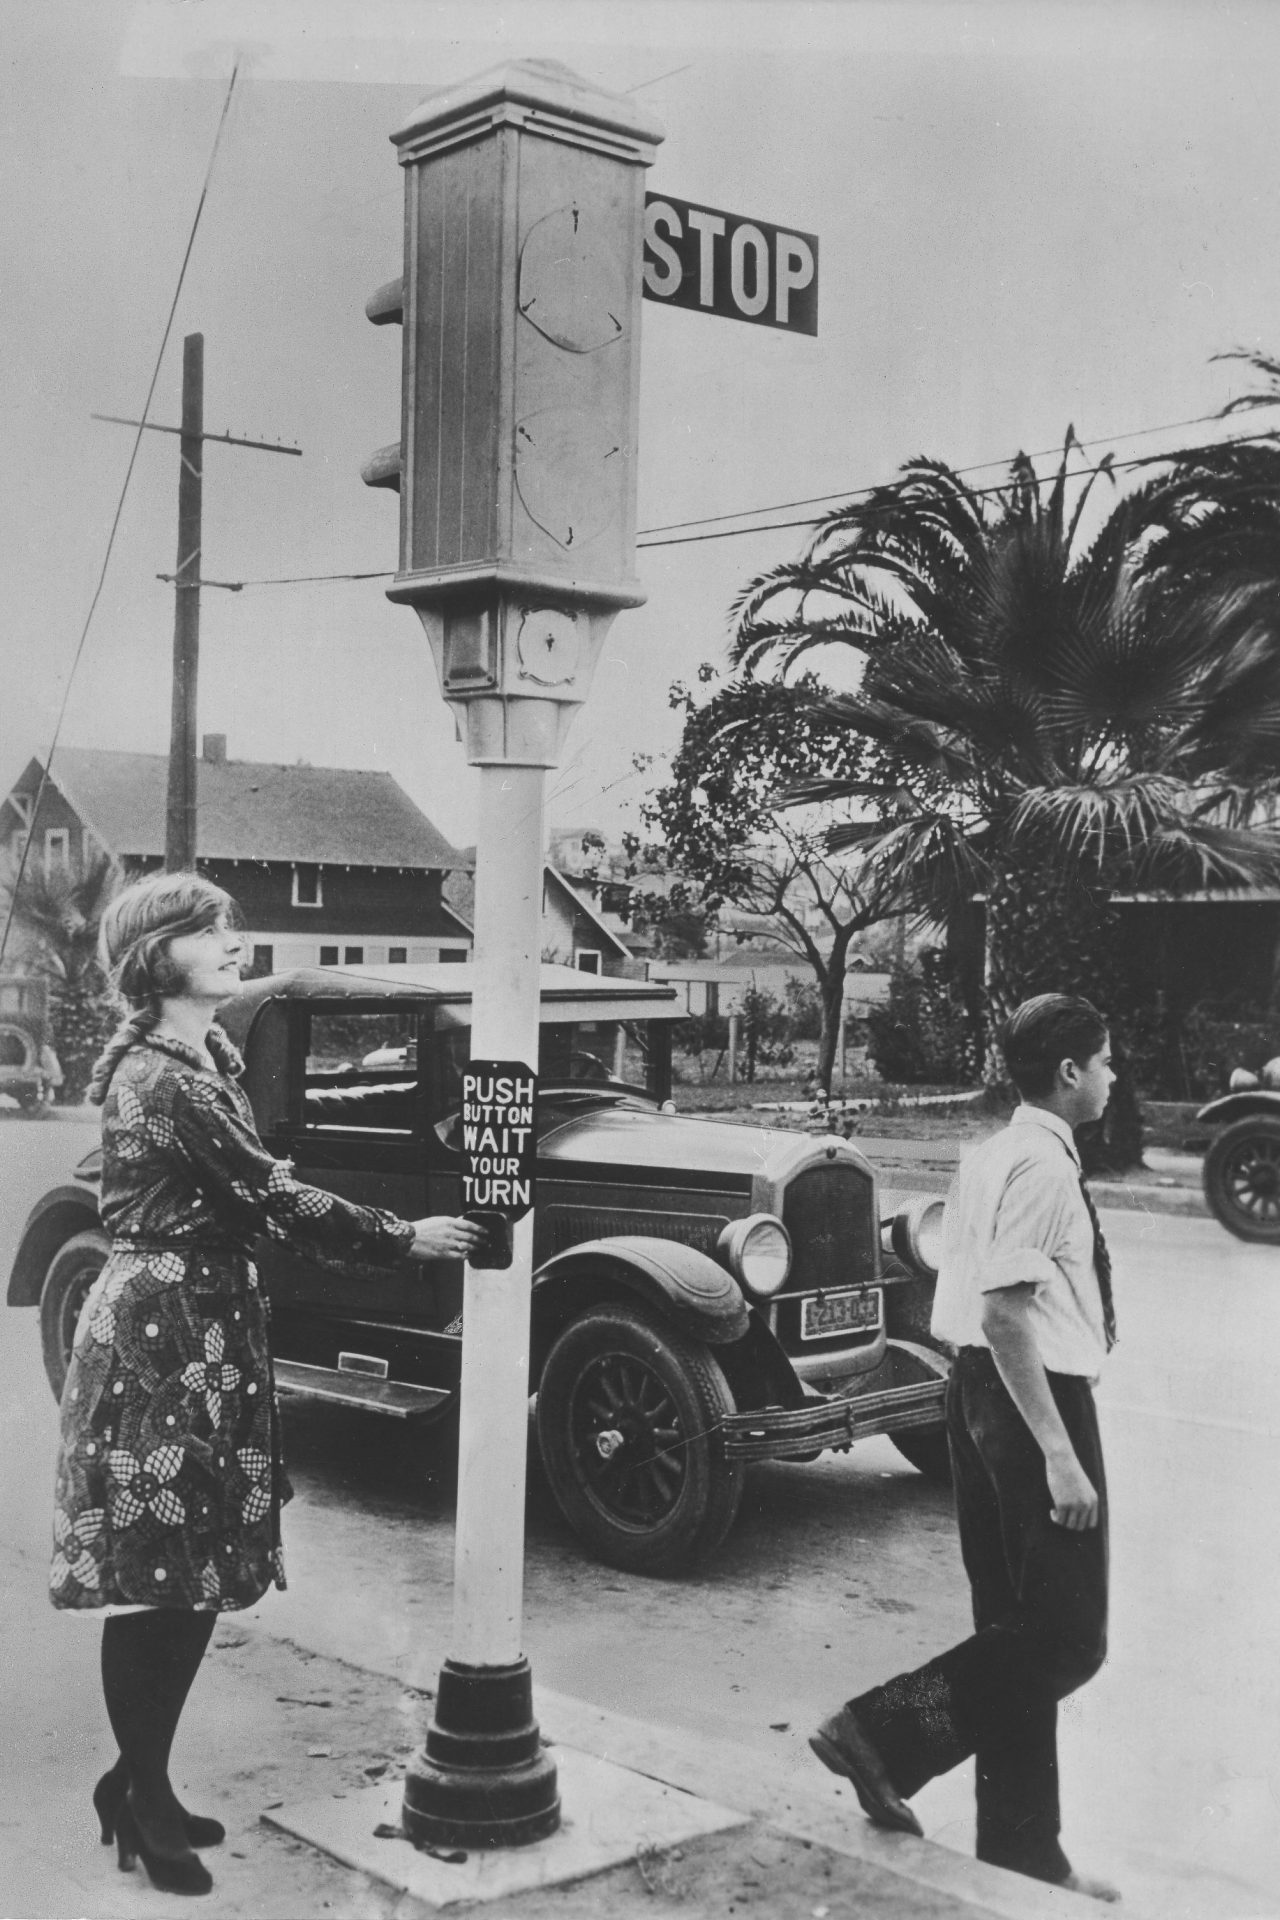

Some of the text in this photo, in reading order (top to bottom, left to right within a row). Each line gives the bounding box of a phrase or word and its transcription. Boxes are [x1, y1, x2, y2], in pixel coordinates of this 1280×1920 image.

[643, 200, 815, 323] STOP
[463, 1075, 534, 1104] PUSH
[463, 1102, 533, 1124] BUTTON
[463, 1124, 532, 1154] WAIT
[470, 1156, 520, 1176] YOUR
[462, 1175, 530, 1206] TURN
